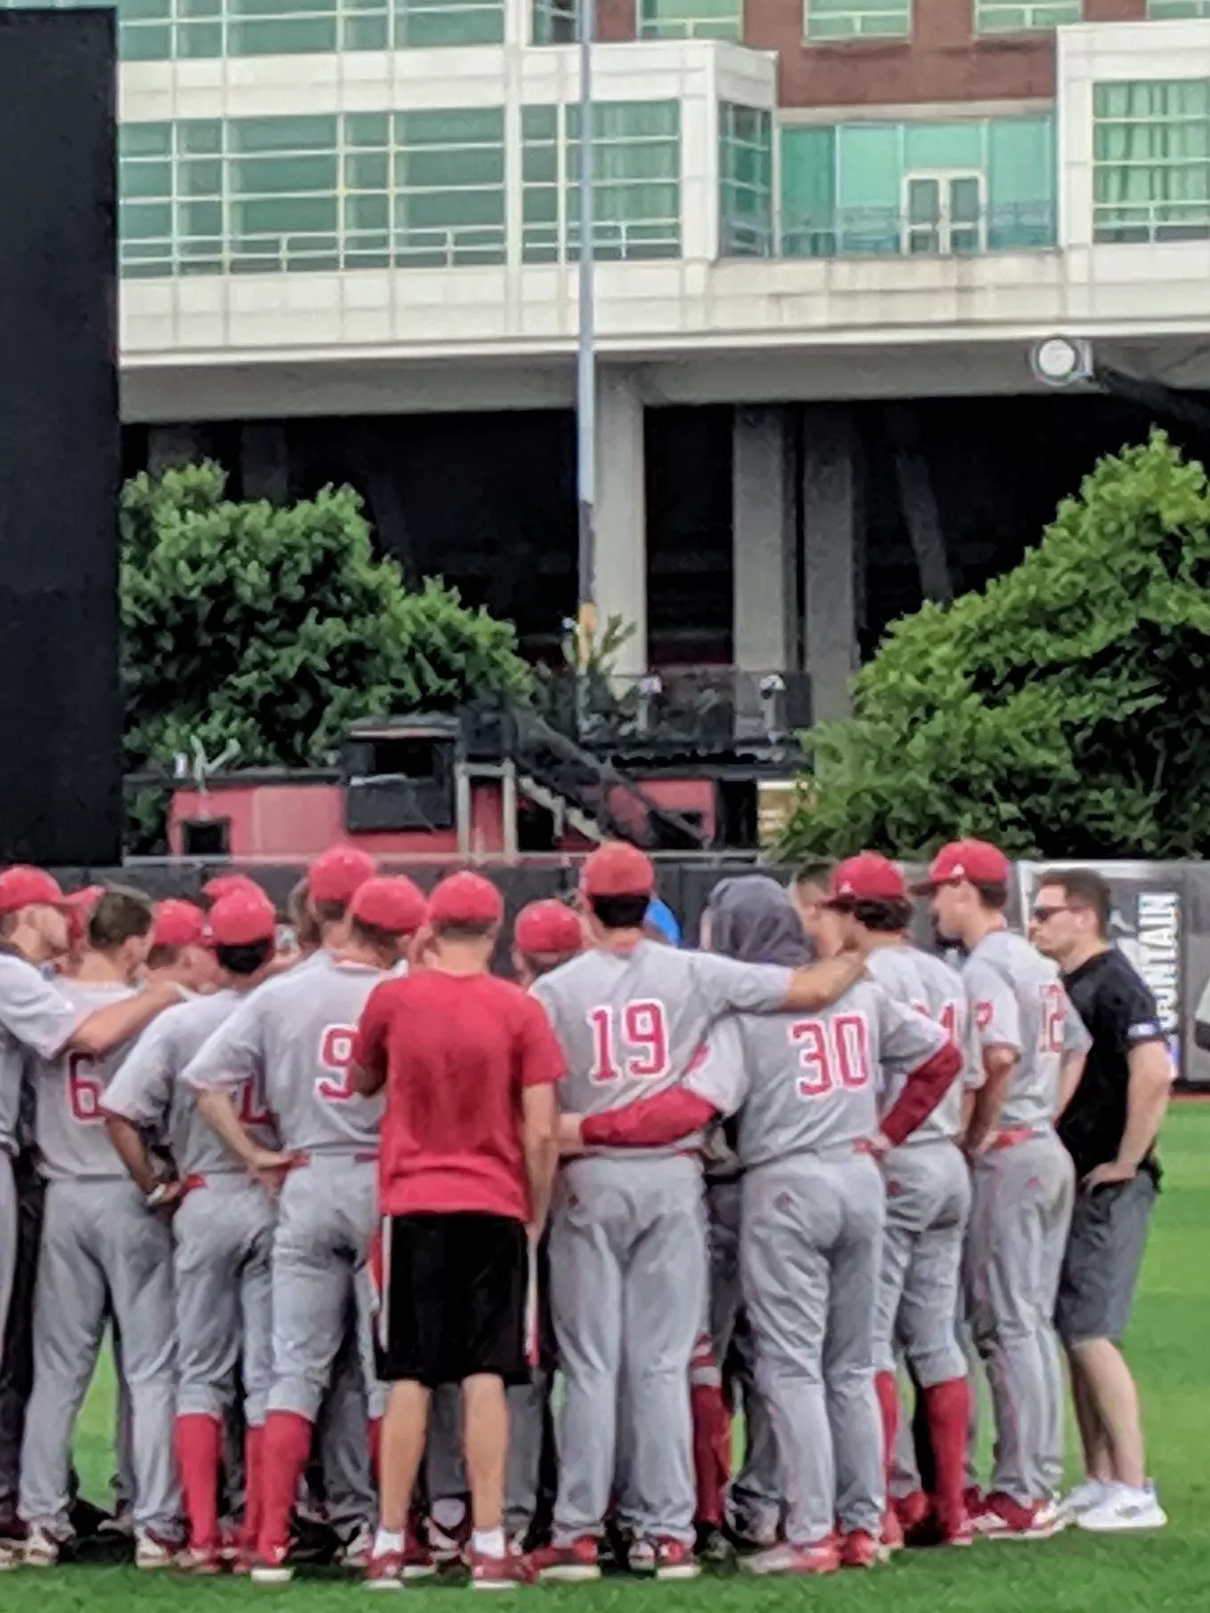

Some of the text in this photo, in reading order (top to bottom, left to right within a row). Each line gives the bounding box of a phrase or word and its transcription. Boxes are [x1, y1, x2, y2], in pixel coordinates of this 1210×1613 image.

[316, 1025, 358, 1101] 9
[588, 999, 670, 1082] 19
[788, 1012, 870, 1098] 30
[67, 1051, 105, 1123] 6
